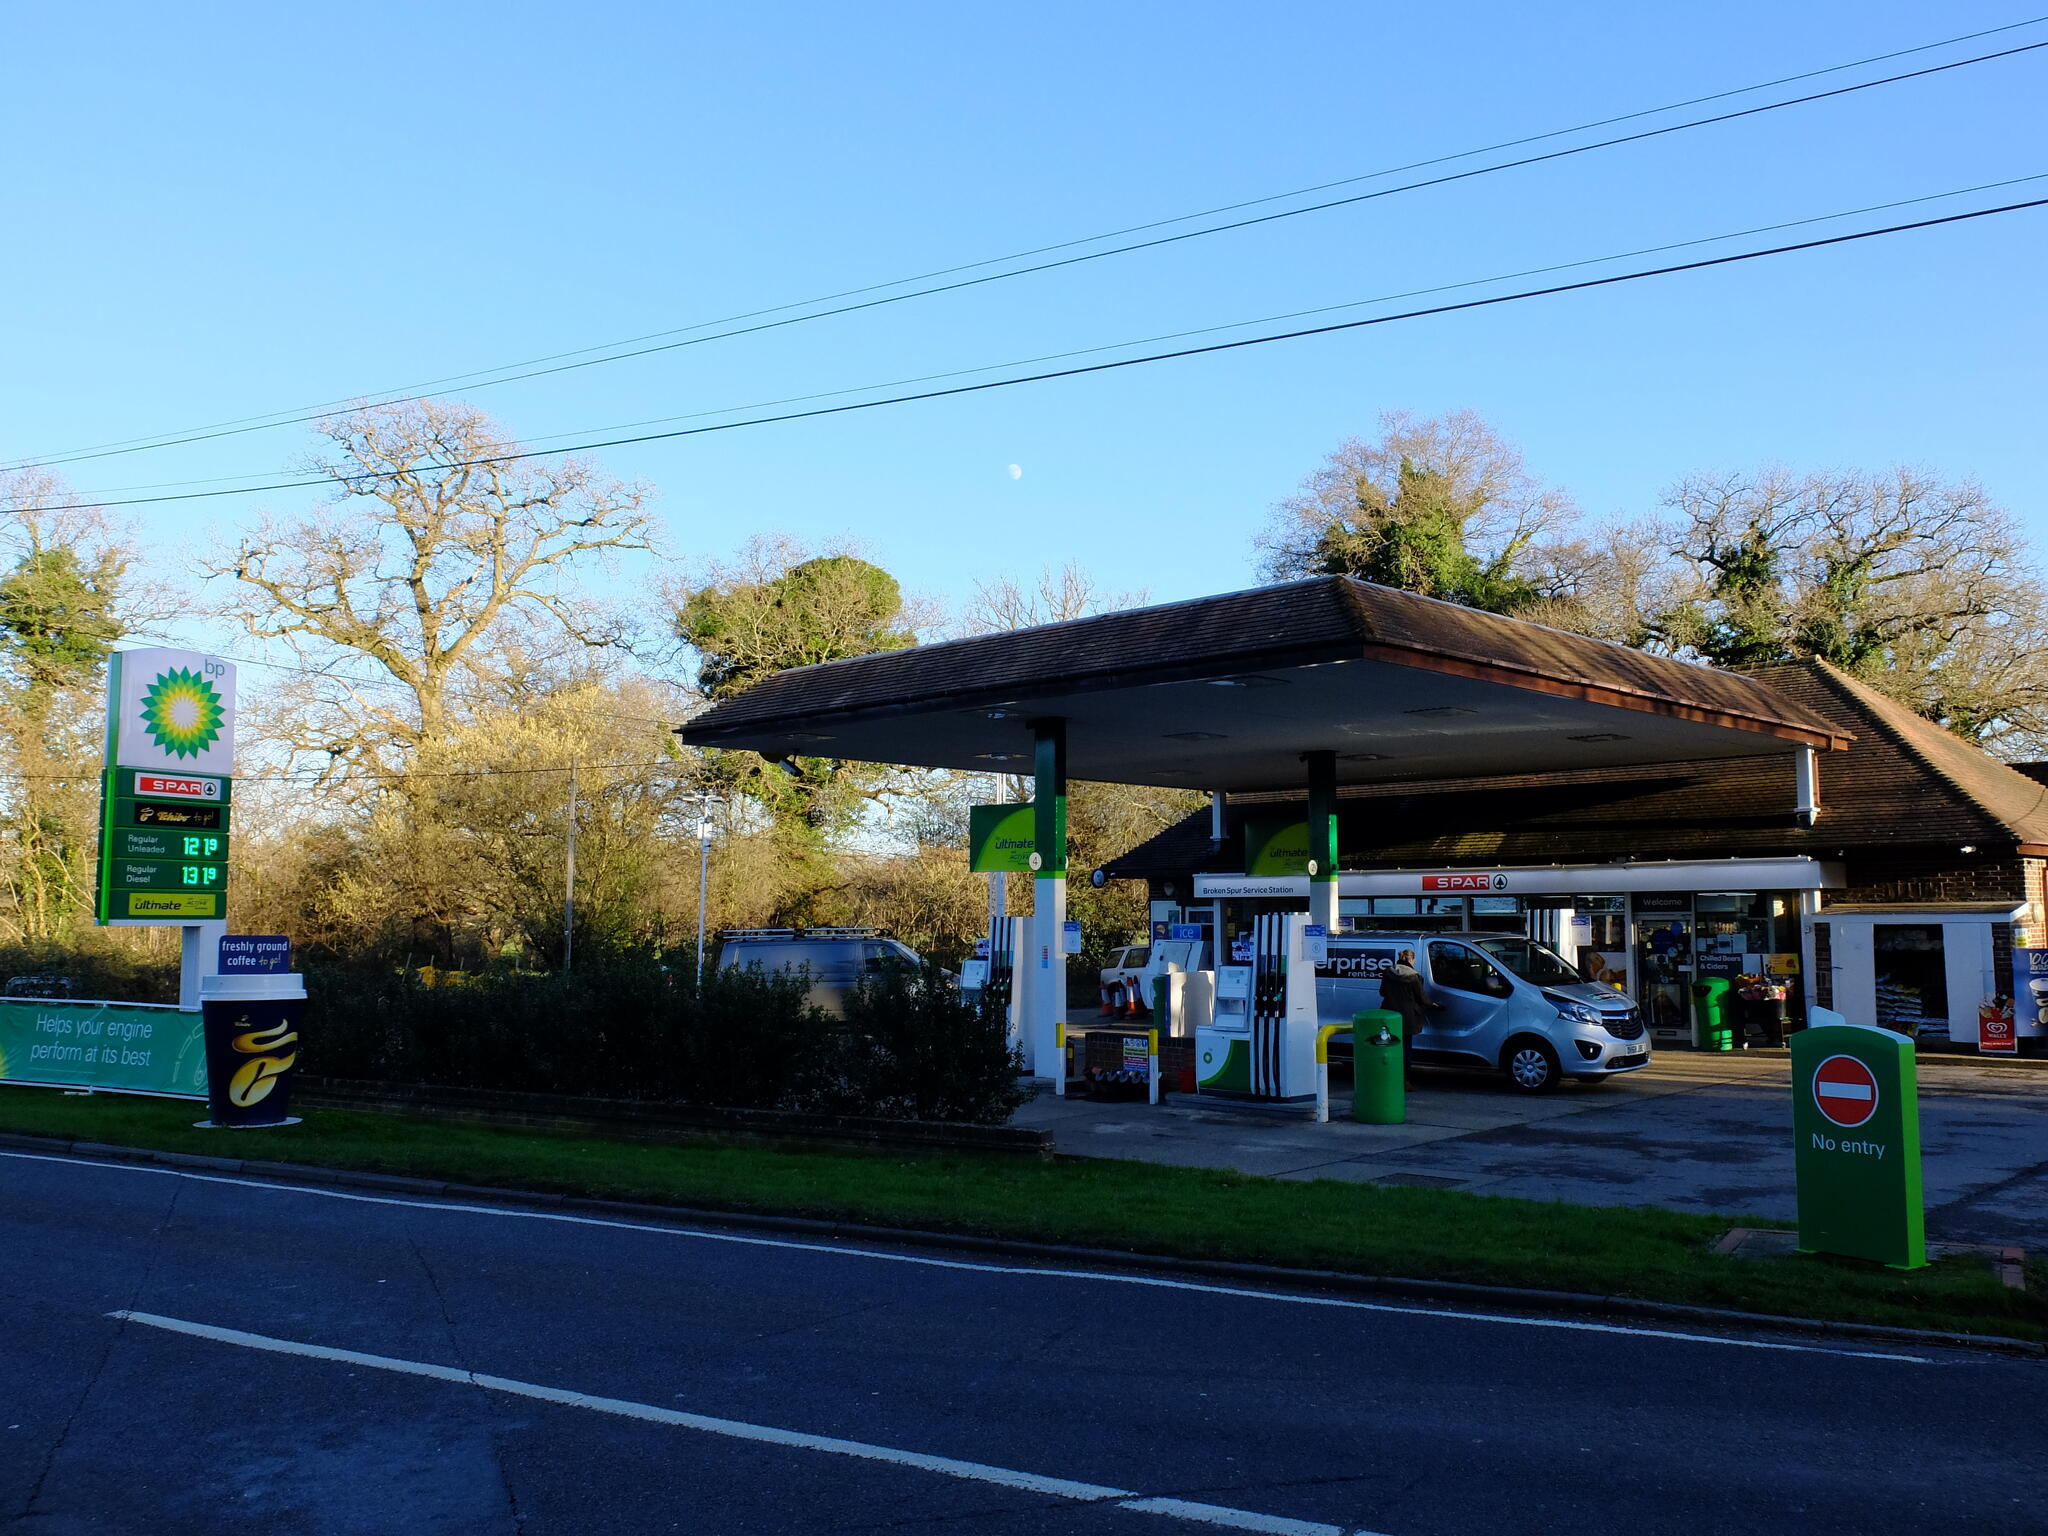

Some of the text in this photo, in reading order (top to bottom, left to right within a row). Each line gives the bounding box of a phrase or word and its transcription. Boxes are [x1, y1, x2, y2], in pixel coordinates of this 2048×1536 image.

[204, 658, 226, 678] bp
[152, 779, 202, 794] SPAR
[127, 834, 159, 845] Regular
[127, 845, 166, 854] Unleaded
[126, 864, 157, 875] Regular
[126, 874, 151, 883] Diesel
[1436, 876, 1489, 889] SPAR
[1203, 885, 1294, 896] Broken Spur Service Station
[1643, 897, 1683, 906] Welcome
[1179, 926, 1194, 938] ice
[222, 941, 288, 954] freshly ground
[227, 955, 257, 966] coffee
[258, 955, 269, 966] to
[36, 1012, 153, 1041] Helps your engine
[30, 1043, 152, 1067] perform at its best
[1811, 1132, 1885, 1161] No entry
